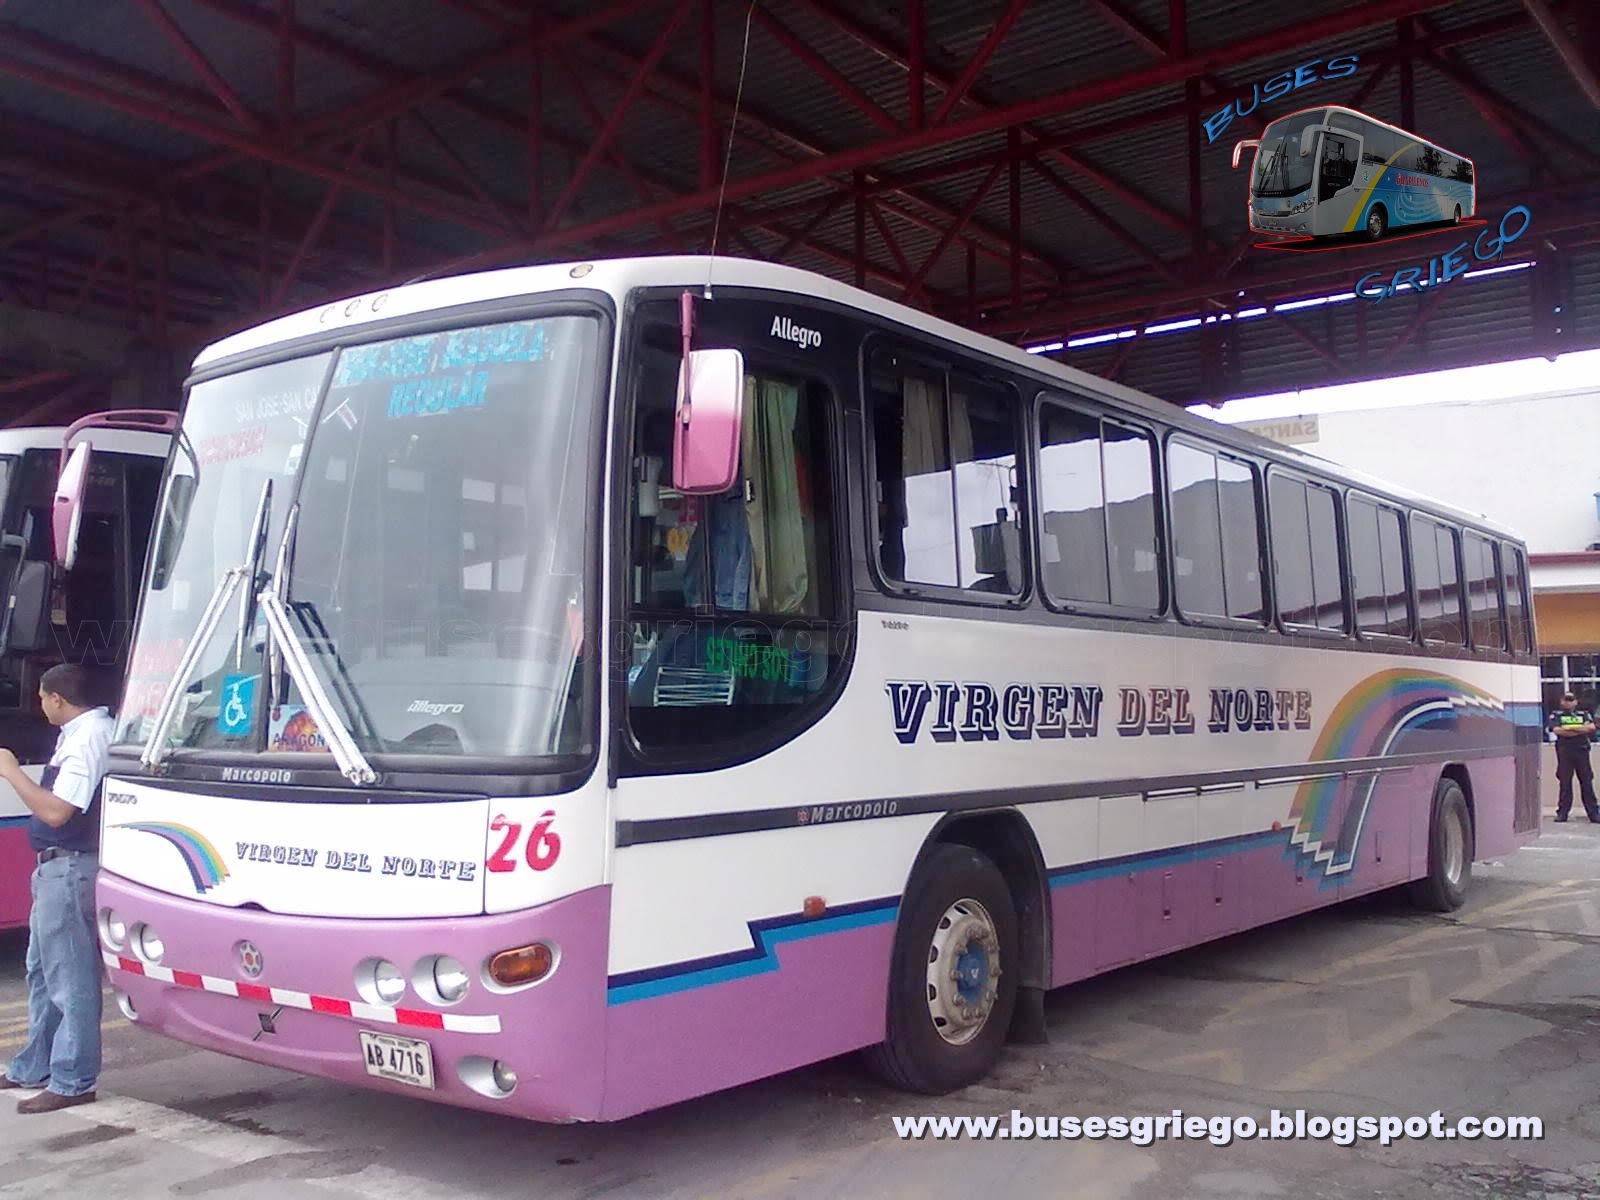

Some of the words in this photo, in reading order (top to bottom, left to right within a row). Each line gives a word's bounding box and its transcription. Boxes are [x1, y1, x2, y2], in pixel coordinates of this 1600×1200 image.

[770, 315, 822, 349] Allegro
[407, 700, 465, 716] Allegro
[884, 679, 1104, 744] VIRGEN
[1116, 686, 1195, 737] DEL
[1207, 688, 1312, 733] NORTE
[222, 767, 292, 783] Marcopolo
[811, 800, 898, 823] Marcopolo
[486, 810, 561, 873] 26
[235, 842, 318, 866] VIRGEN
[325, 850, 371, 873] DEL
[381, 856, 476, 881] NORTE
[367, 1043, 384, 1067] AB
[390, 1047, 424, 1076] 4716
